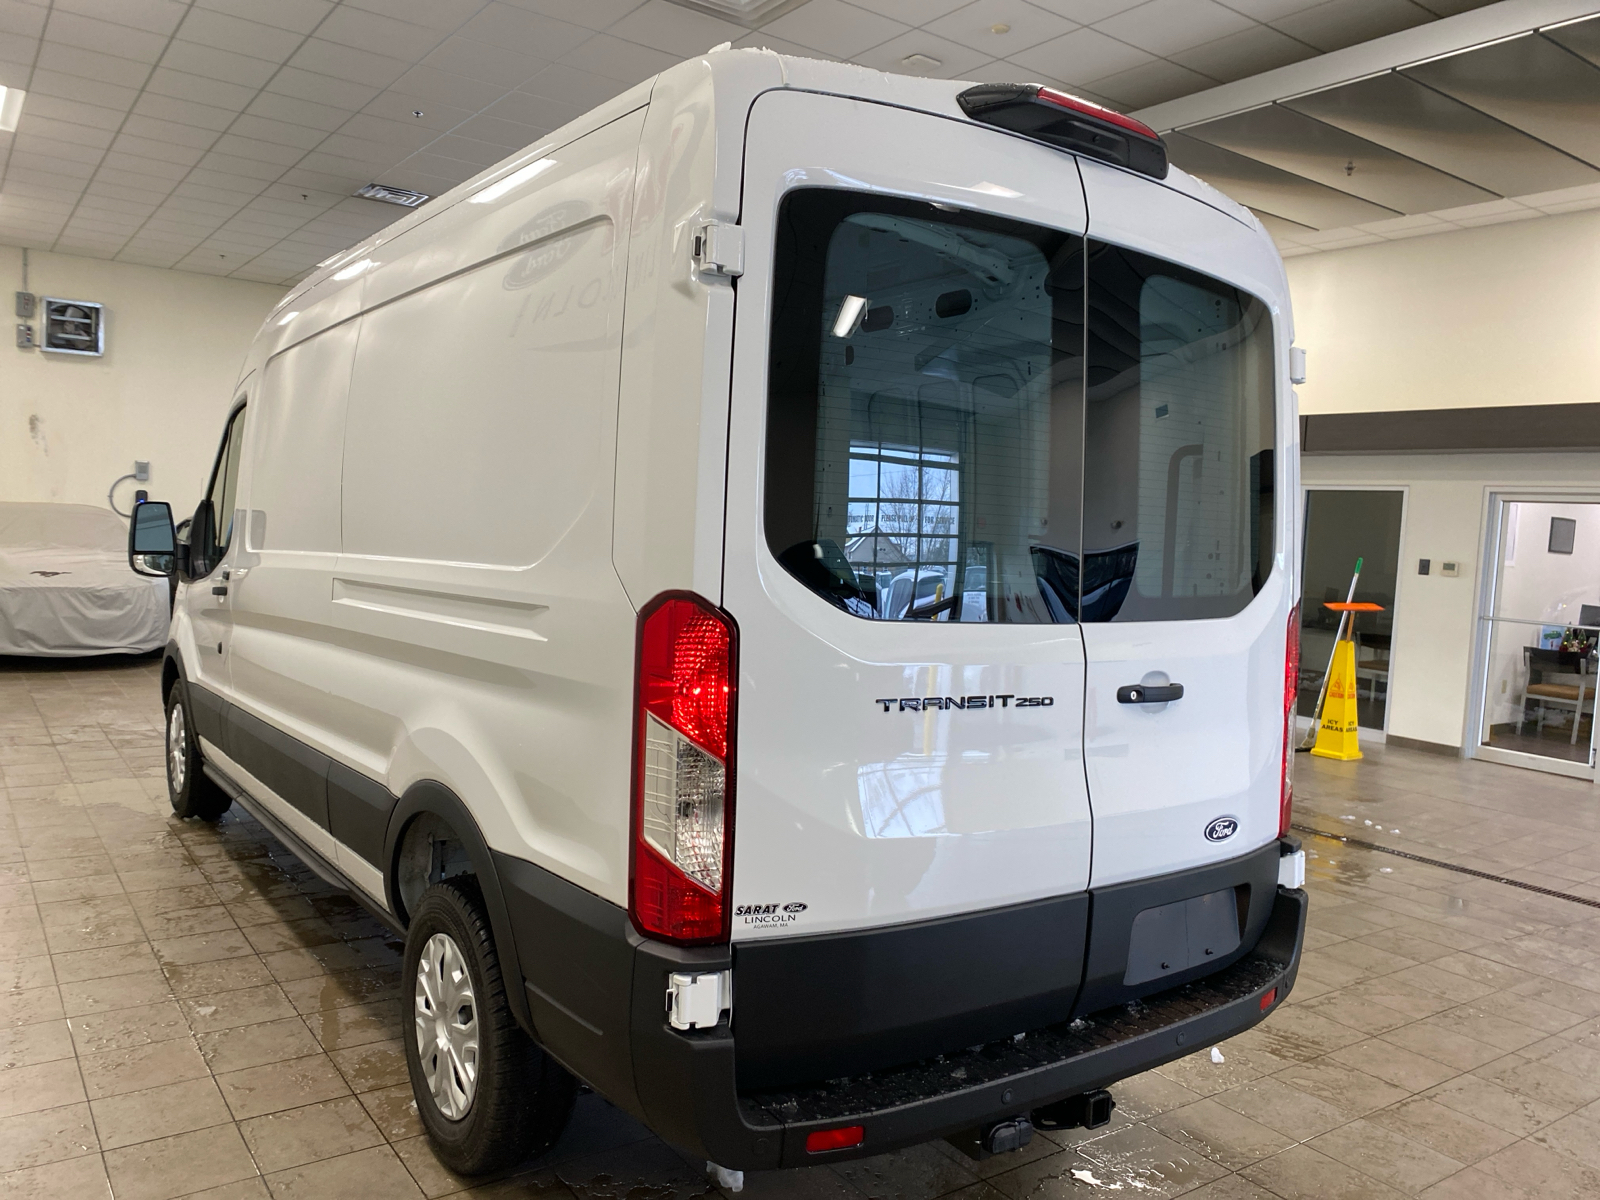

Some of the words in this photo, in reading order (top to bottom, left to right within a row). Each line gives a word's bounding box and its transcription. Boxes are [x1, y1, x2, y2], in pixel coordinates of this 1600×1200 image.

[876, 694, 1014, 712] TRANSIT
[1015, 696, 1054, 707] 250
[1322, 724, 1343, 732] AREAS
[1209, 819, 1235, 840] Ford
[735, 904, 779, 915] SARAT
[785, 903, 805, 912] Ford
[745, 915, 796, 924] LINCOLN
